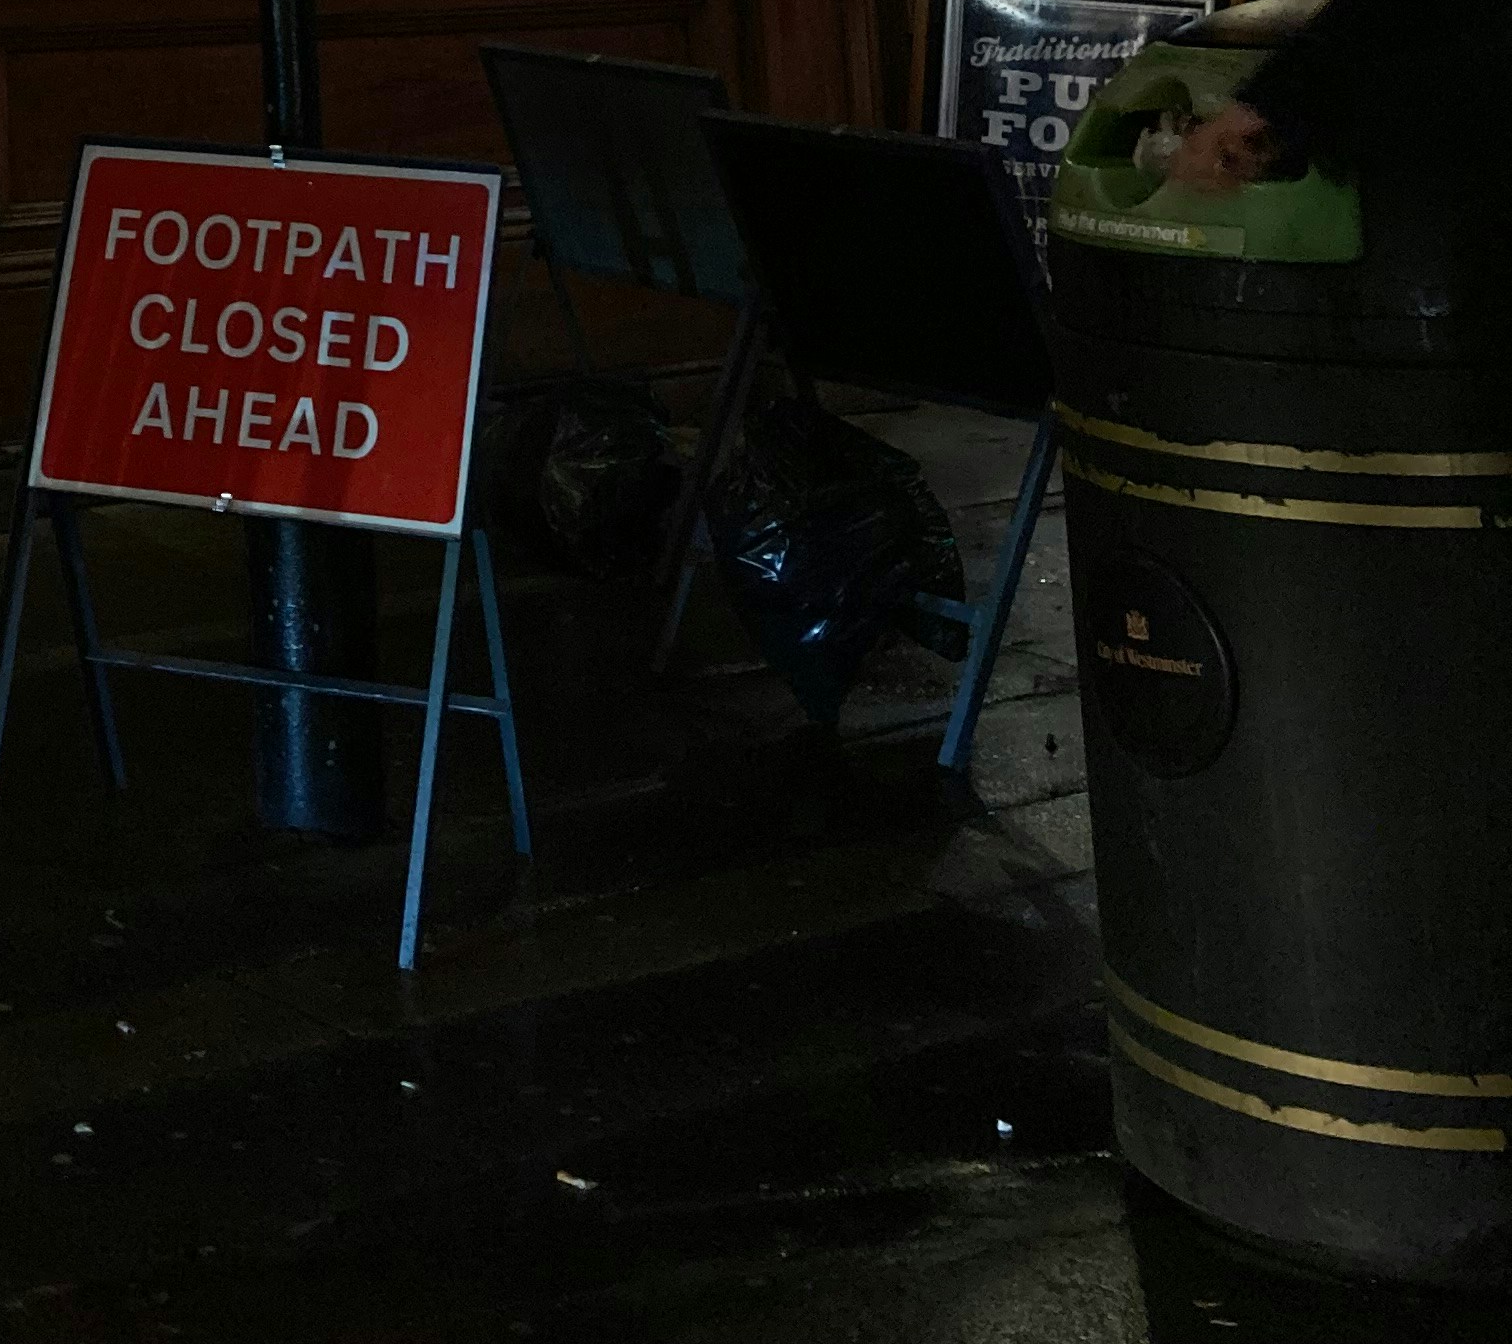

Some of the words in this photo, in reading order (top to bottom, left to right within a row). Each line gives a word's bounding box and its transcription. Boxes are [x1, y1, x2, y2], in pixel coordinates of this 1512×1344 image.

[970, 33, 1148, 68] Traditional
[998, 68, 1114, 112] PU
[981, 110, 1070, 153] FO
[104, 207, 460, 289] FOOTPATH
[129, 293, 409, 372] CLOSED
[131, 381, 379, 459] AHEAD
